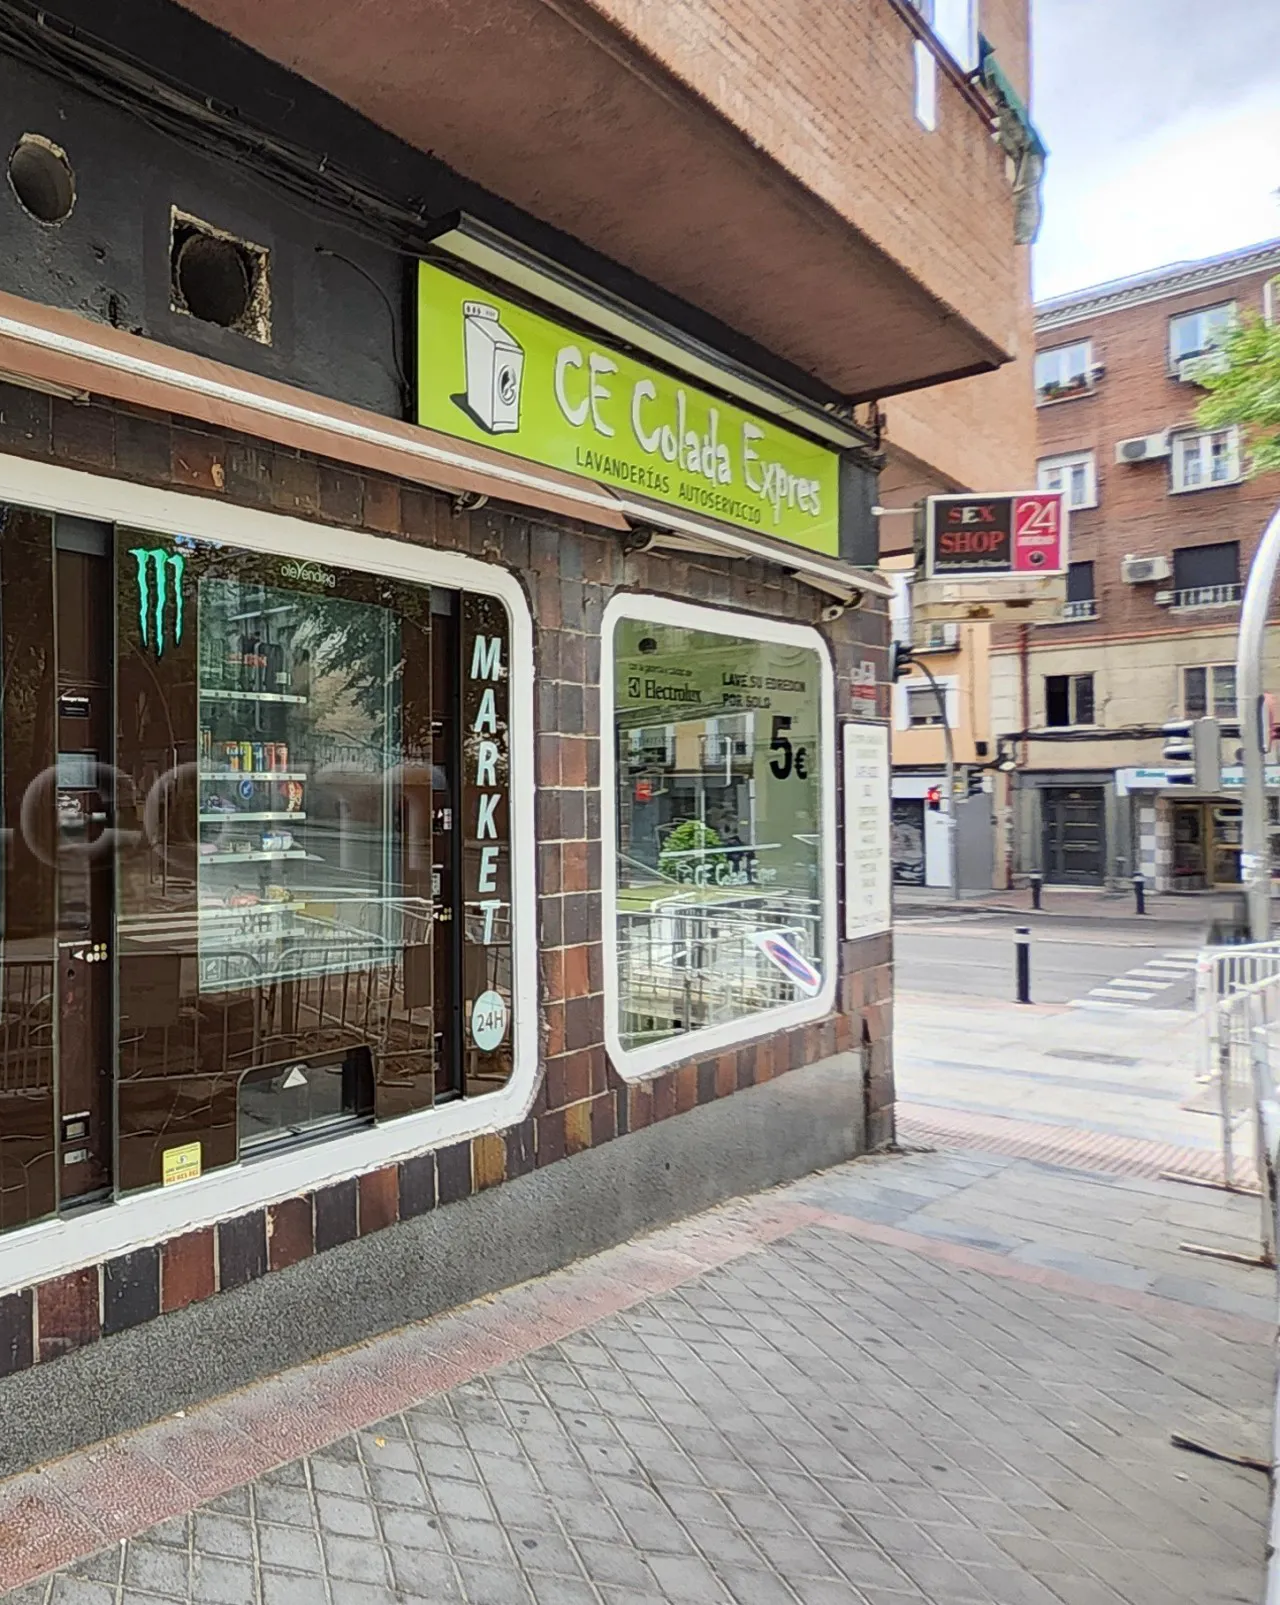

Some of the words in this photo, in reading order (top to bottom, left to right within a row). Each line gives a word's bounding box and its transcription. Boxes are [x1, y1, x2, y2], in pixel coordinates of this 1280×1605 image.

[554, 345, 620, 437] CE
[631, 379, 731, 486] Colada
[743, 421, 821, 525] Expres
[576, 446, 670, 494] LAVANDERÍAS
[678, 480, 762, 524] AUTOSERVICIO
[948, 504, 996, 524] SEX
[1017, 500, 1057, 537] 24
[939, 531, 1005, 554] SHOP
[645, 680, 701, 704] Electrolux
[470, 635, 511, 945] MARKET
[476, 1010, 505, 1034] 24H
